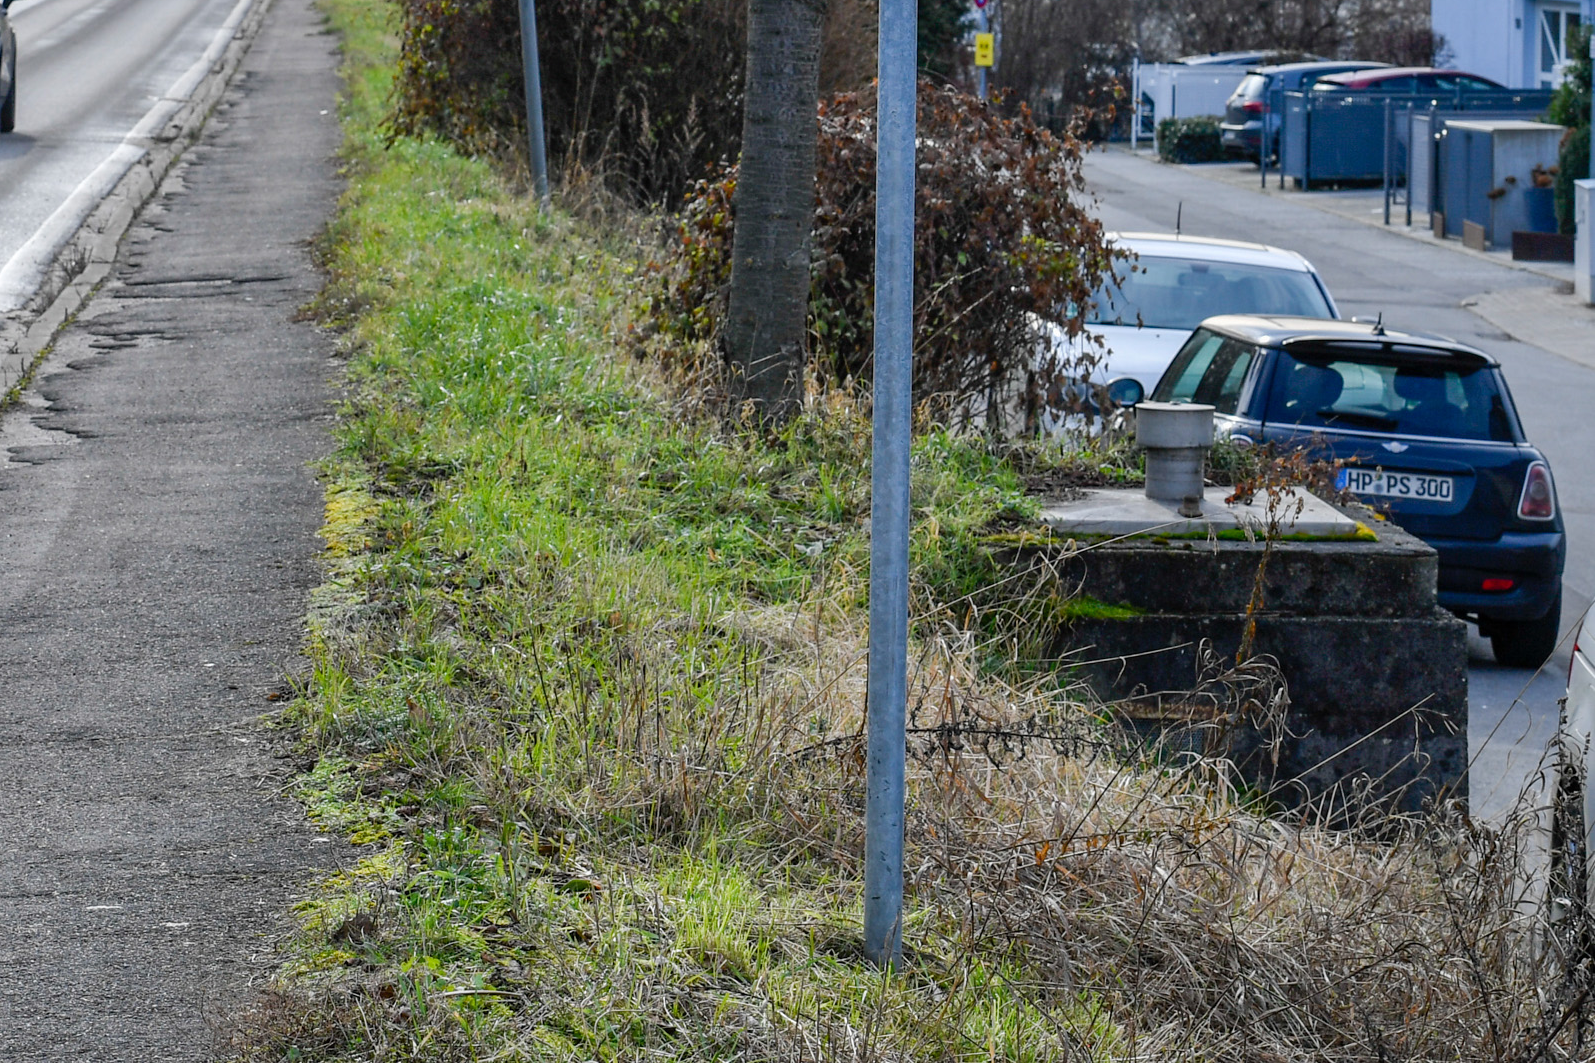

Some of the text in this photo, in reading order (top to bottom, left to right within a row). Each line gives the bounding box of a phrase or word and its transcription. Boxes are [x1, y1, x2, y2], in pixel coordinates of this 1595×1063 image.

[1347, 471, 1451, 498] HP PS 300
